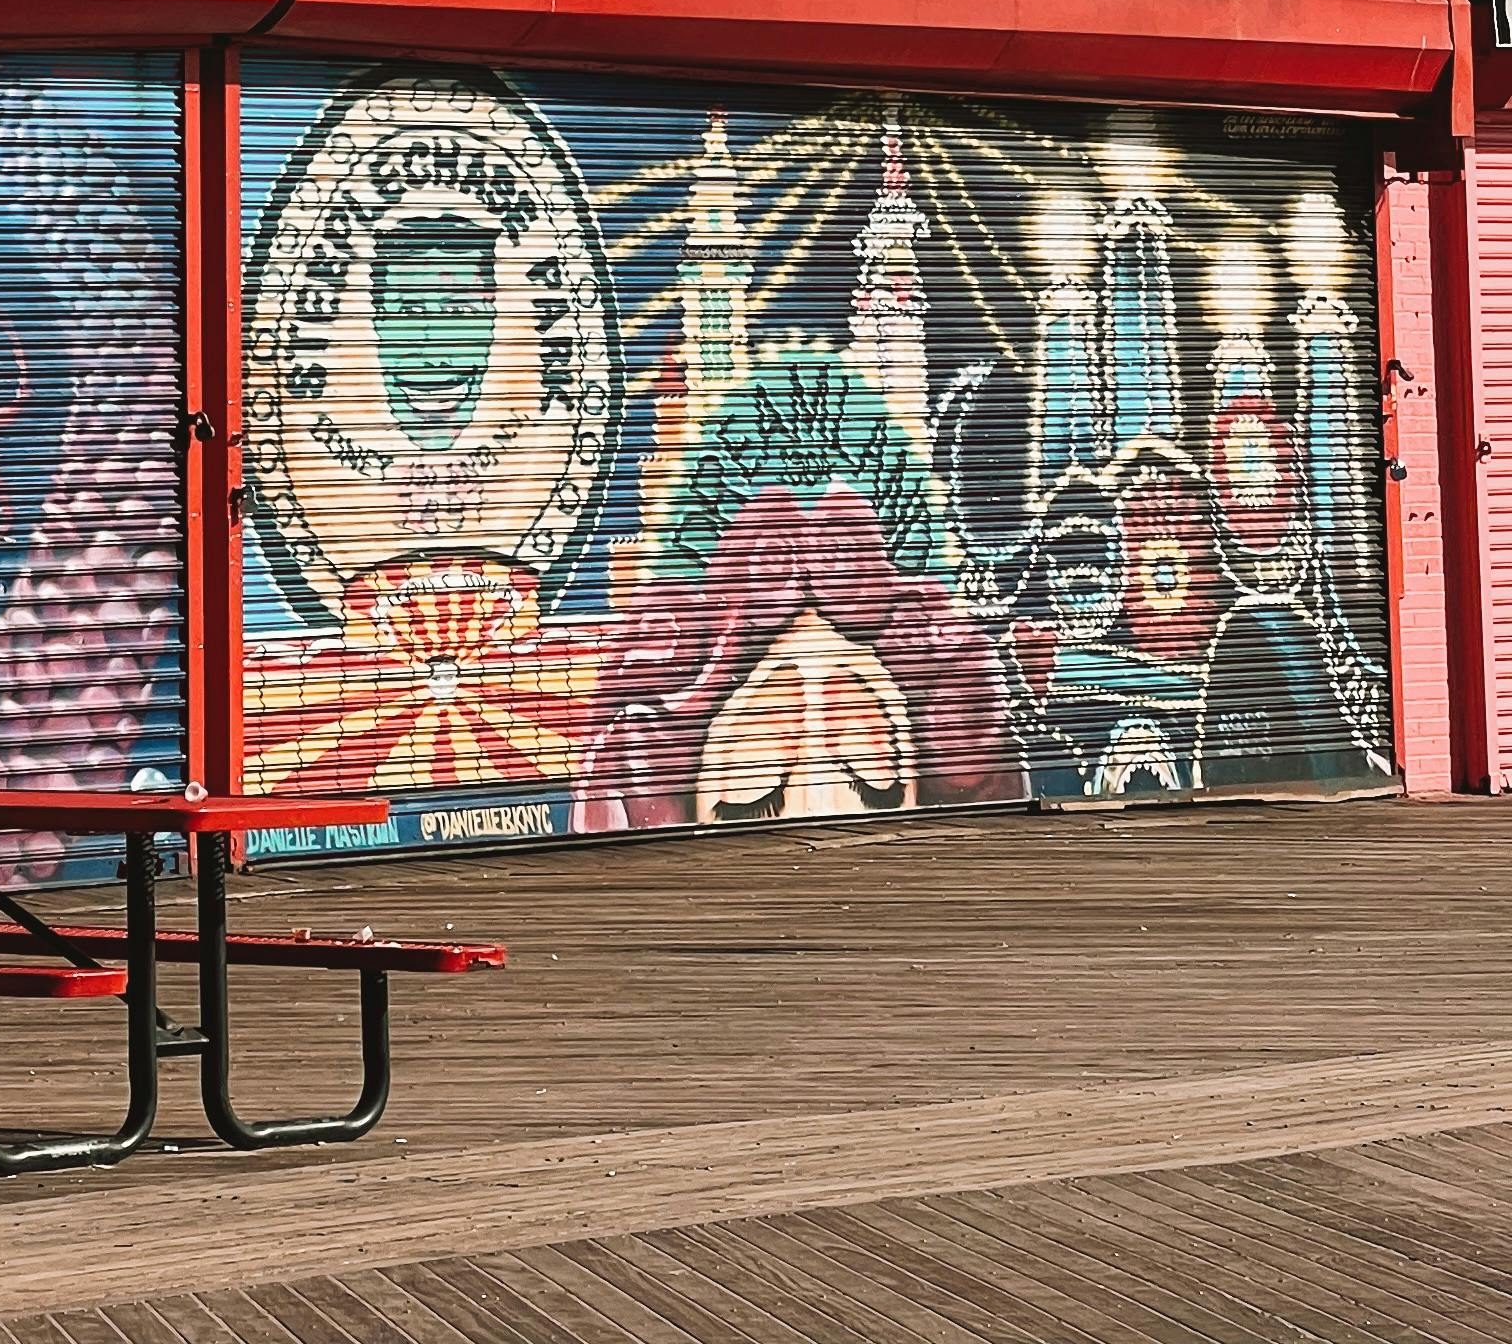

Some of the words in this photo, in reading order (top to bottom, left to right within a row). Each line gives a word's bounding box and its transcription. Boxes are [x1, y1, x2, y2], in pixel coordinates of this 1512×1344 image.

[525, 256, 575, 417] PARK
[246, 826, 322, 854] DANIELLE
[420, 803, 554, 841] @DANIELLEBKNYC
